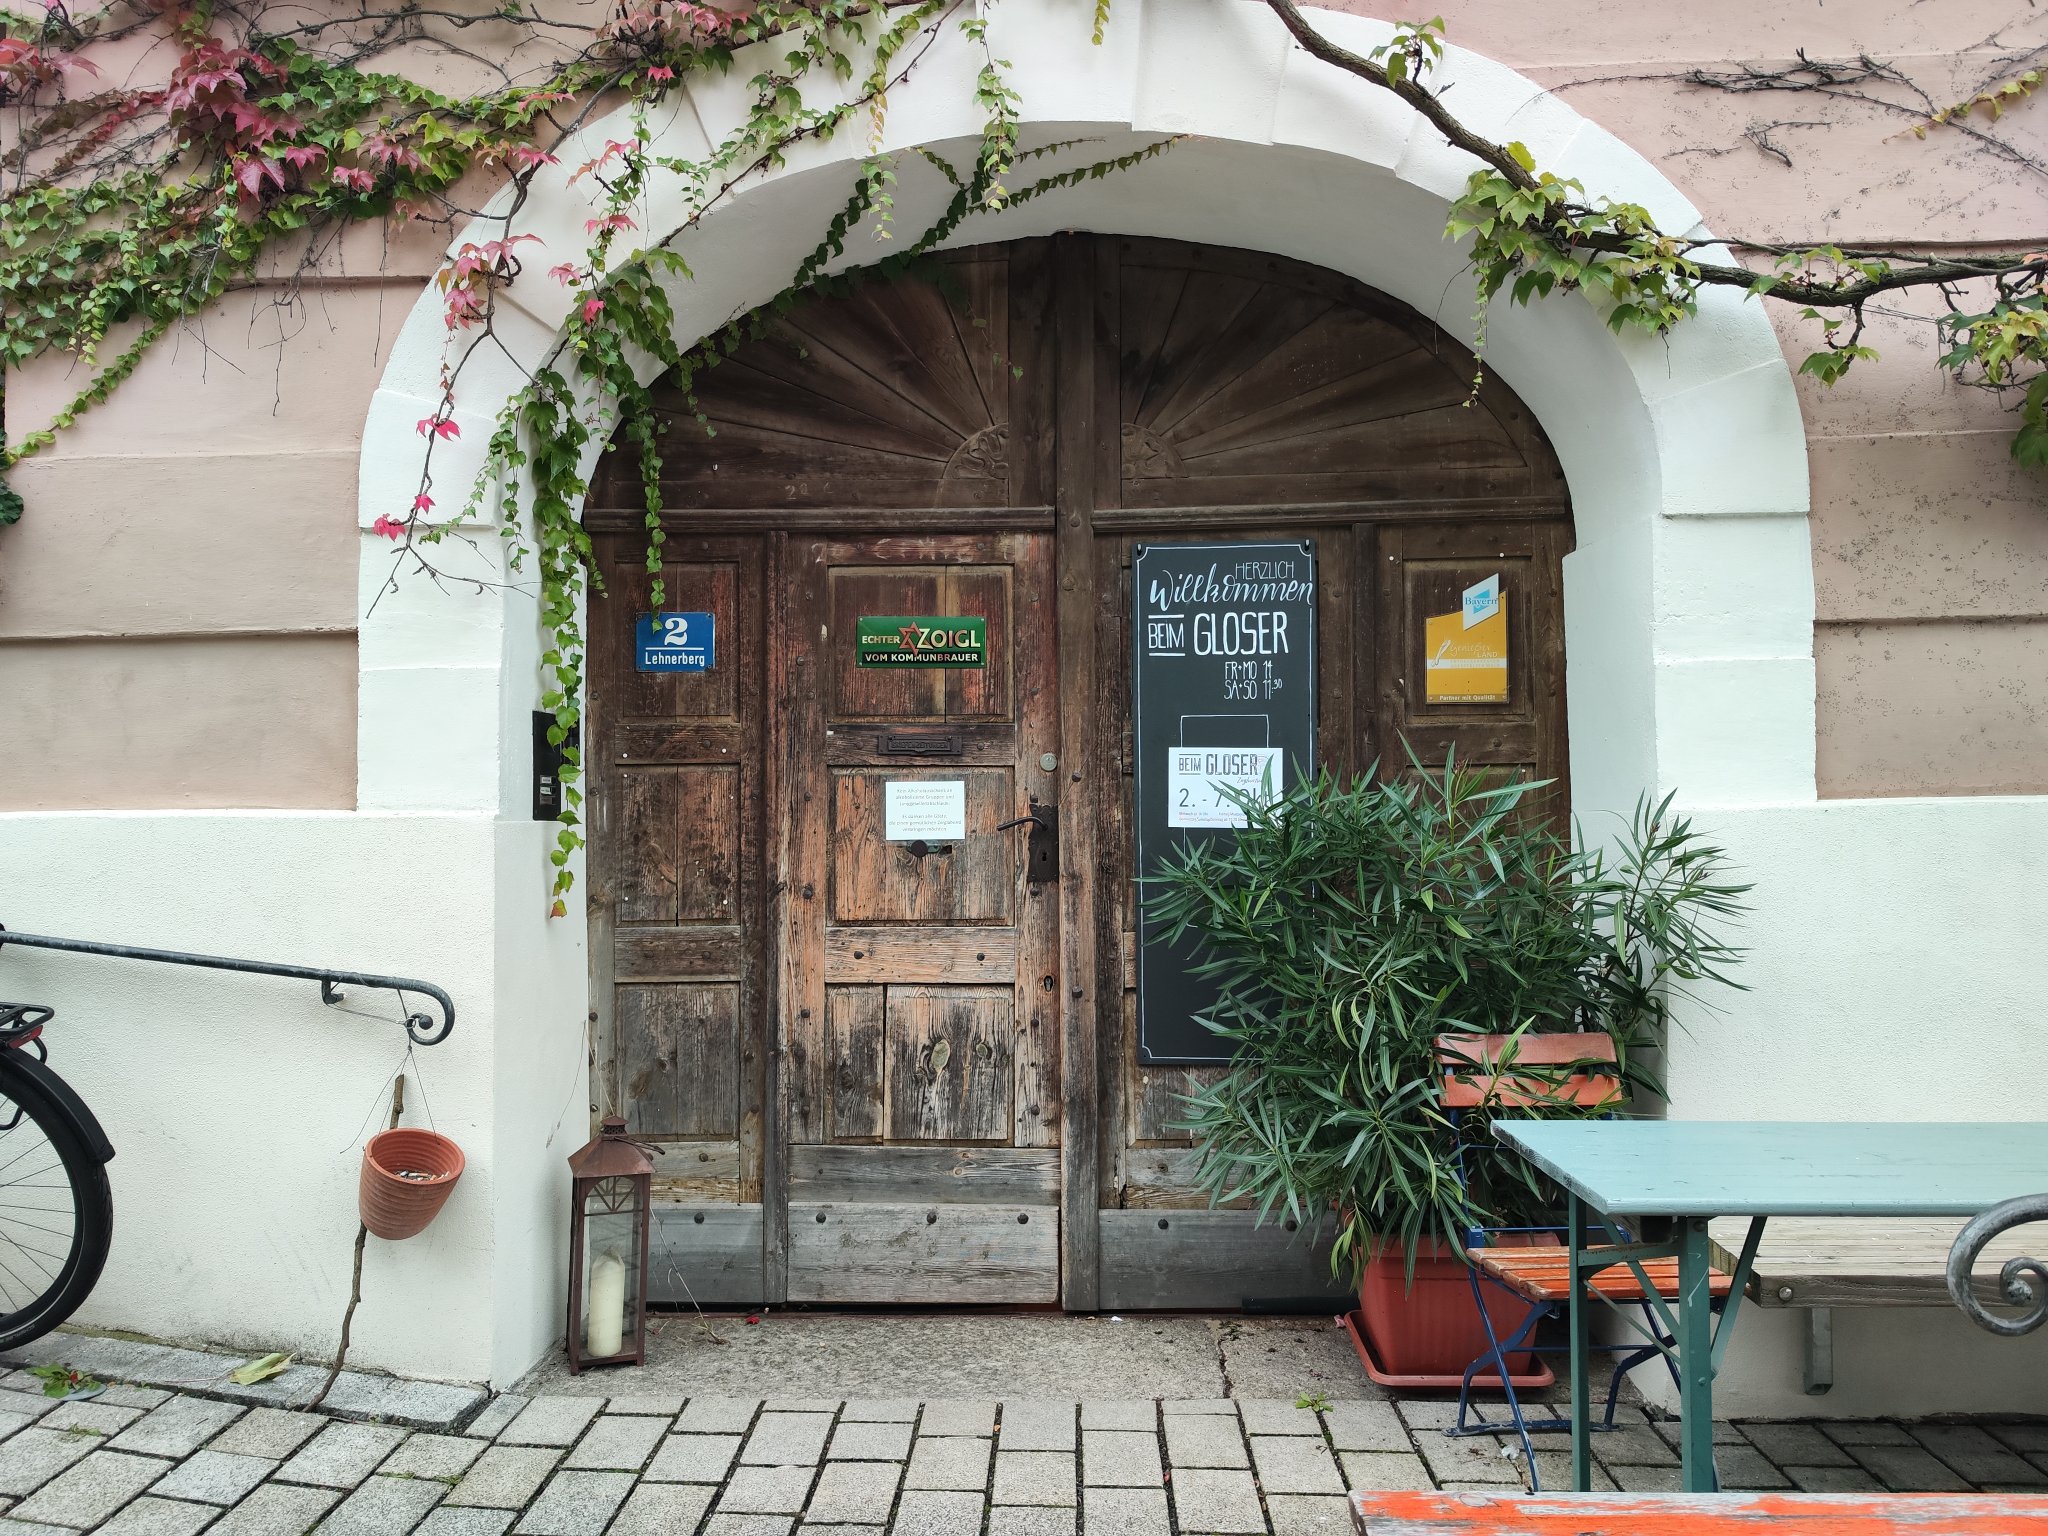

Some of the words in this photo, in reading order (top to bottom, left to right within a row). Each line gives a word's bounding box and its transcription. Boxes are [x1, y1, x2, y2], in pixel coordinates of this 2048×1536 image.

[1235, 561, 1294, 580] HERZLICH
[1149, 563, 1313, 612] Willkommen
[1465, 597, 1498, 607] Bayern
[664, 617, 688, 646] 2
[862, 635, 900, 644] ECHTER
[916, 628, 981, 650] ZOIGL
[1148, 622, 1184, 649] BEIM
[1194, 611, 1289, 656] GLOSER
[645, 652, 705, 666] Lehnerberg
[865, 653, 888, 662] VOM
[891, 653, 979, 662] KOMMUNBRAUER
[1262, 660, 1273, 680] 14
[1179, 757, 1201, 772] BEIM
[1205, 753, 1259, 776] GLOSER
[1179, 787, 1196, 808] 2.
